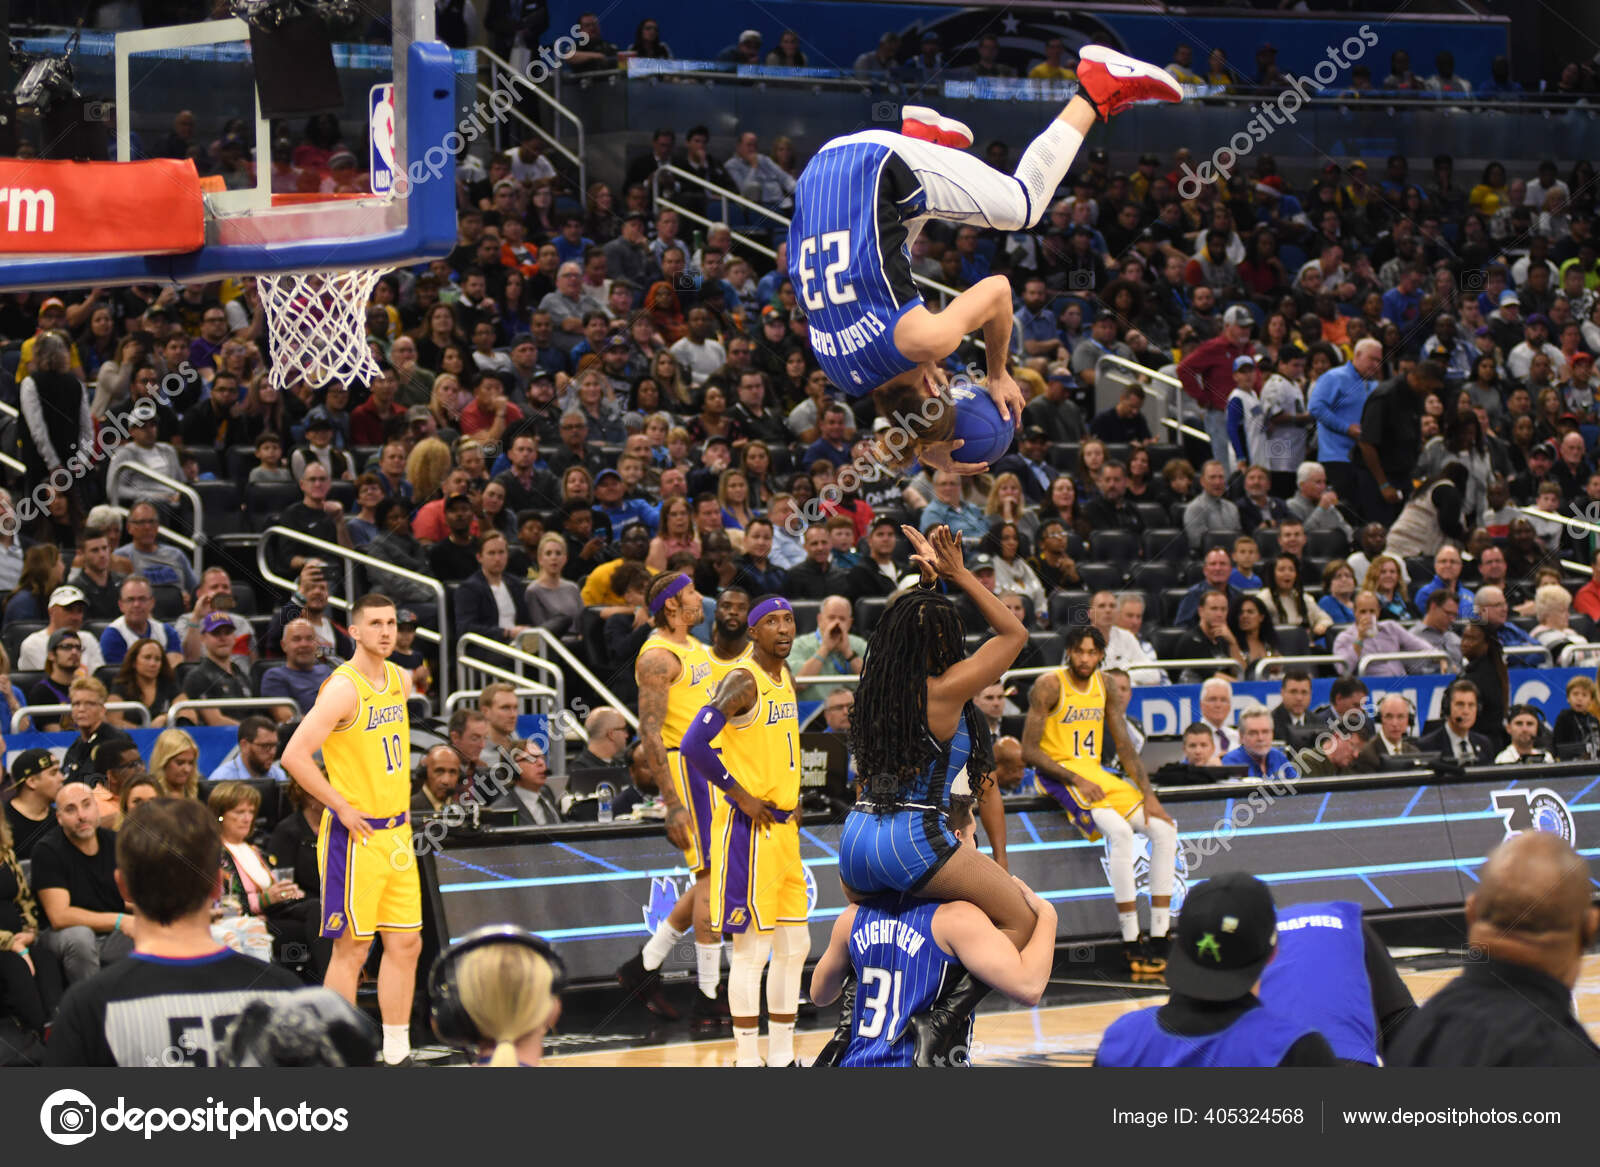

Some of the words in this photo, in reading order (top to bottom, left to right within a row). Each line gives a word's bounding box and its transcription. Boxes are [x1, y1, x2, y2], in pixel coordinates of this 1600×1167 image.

[798, 229, 857, 311] 23
[836, 311, 886, 356] FLIGHT
[364, 703, 403, 731] LAKERS
[382, 733, 402, 774] 10
[1074, 730, 1096, 758] 14
[853, 919, 897, 955] FLIGHT
[896, 920, 926, 958] CREW
[857, 966, 903, 1041] 31
